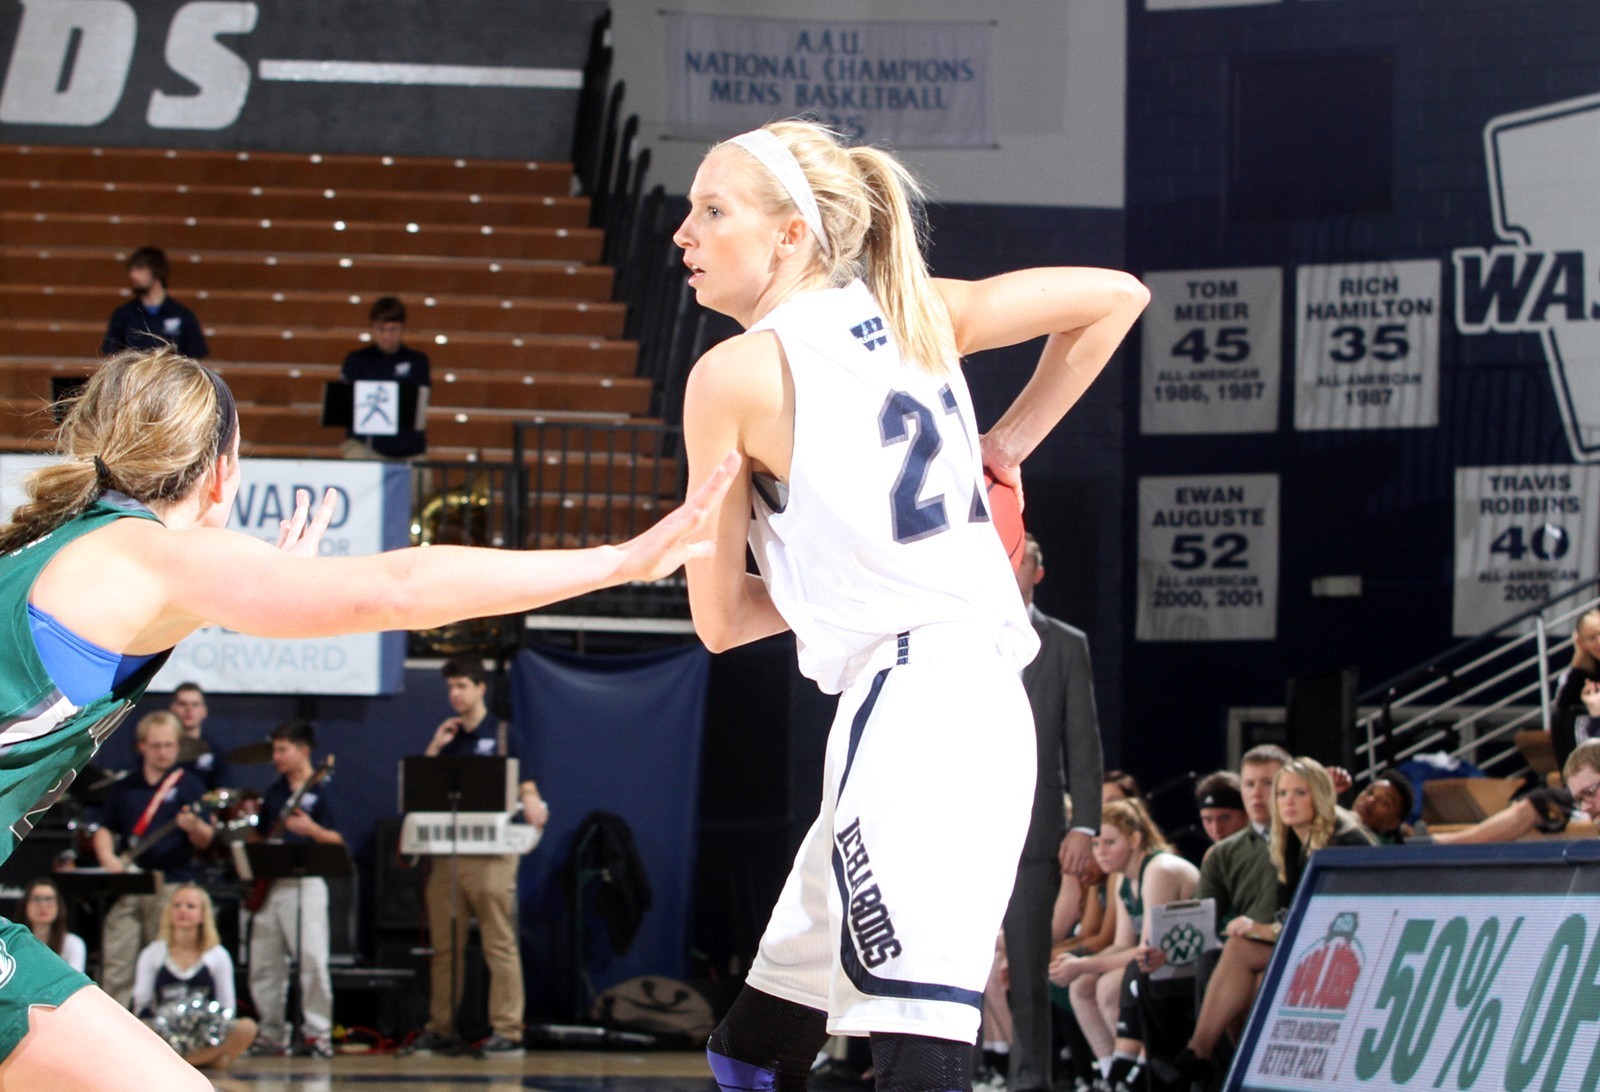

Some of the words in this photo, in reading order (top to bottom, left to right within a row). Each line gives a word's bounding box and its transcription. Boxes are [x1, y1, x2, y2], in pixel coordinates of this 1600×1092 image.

[685, 50, 811, 80] NATIONAL
[822, 57, 976, 83] CHAMPIONS
[795, 83, 946, 110] BASKETBALL
[1187, 280, 1238, 299] TOM
[1340, 276, 1398, 297] RICH
[1456, 249, 1600, 331] WA
[1174, 303, 1249, 322] MEIER
[1306, 300, 1432, 321] HAMILTON
[1170, 327, 1250, 364] 45
[1329, 324, 1410, 363] 35
[1157, 368, 1260, 382] ALL-AMERICAN
[1316, 373, 1422, 387] ALL-AMERICAN
[1345, 388, 1394, 406] 1987
[1489, 473, 1572, 492] TRAVIS
[1175, 485, 1244, 505] EWAN
[1480, 496, 1580, 515] ROBBINS
[1152, 508, 1265, 528] AUGUSTE
[1170, 532, 1250, 571] 52
[1489, 524, 1570, 561] 40
[836, 816, 903, 970] ICHABODS
[1354, 915, 1526, 1090] 50%
